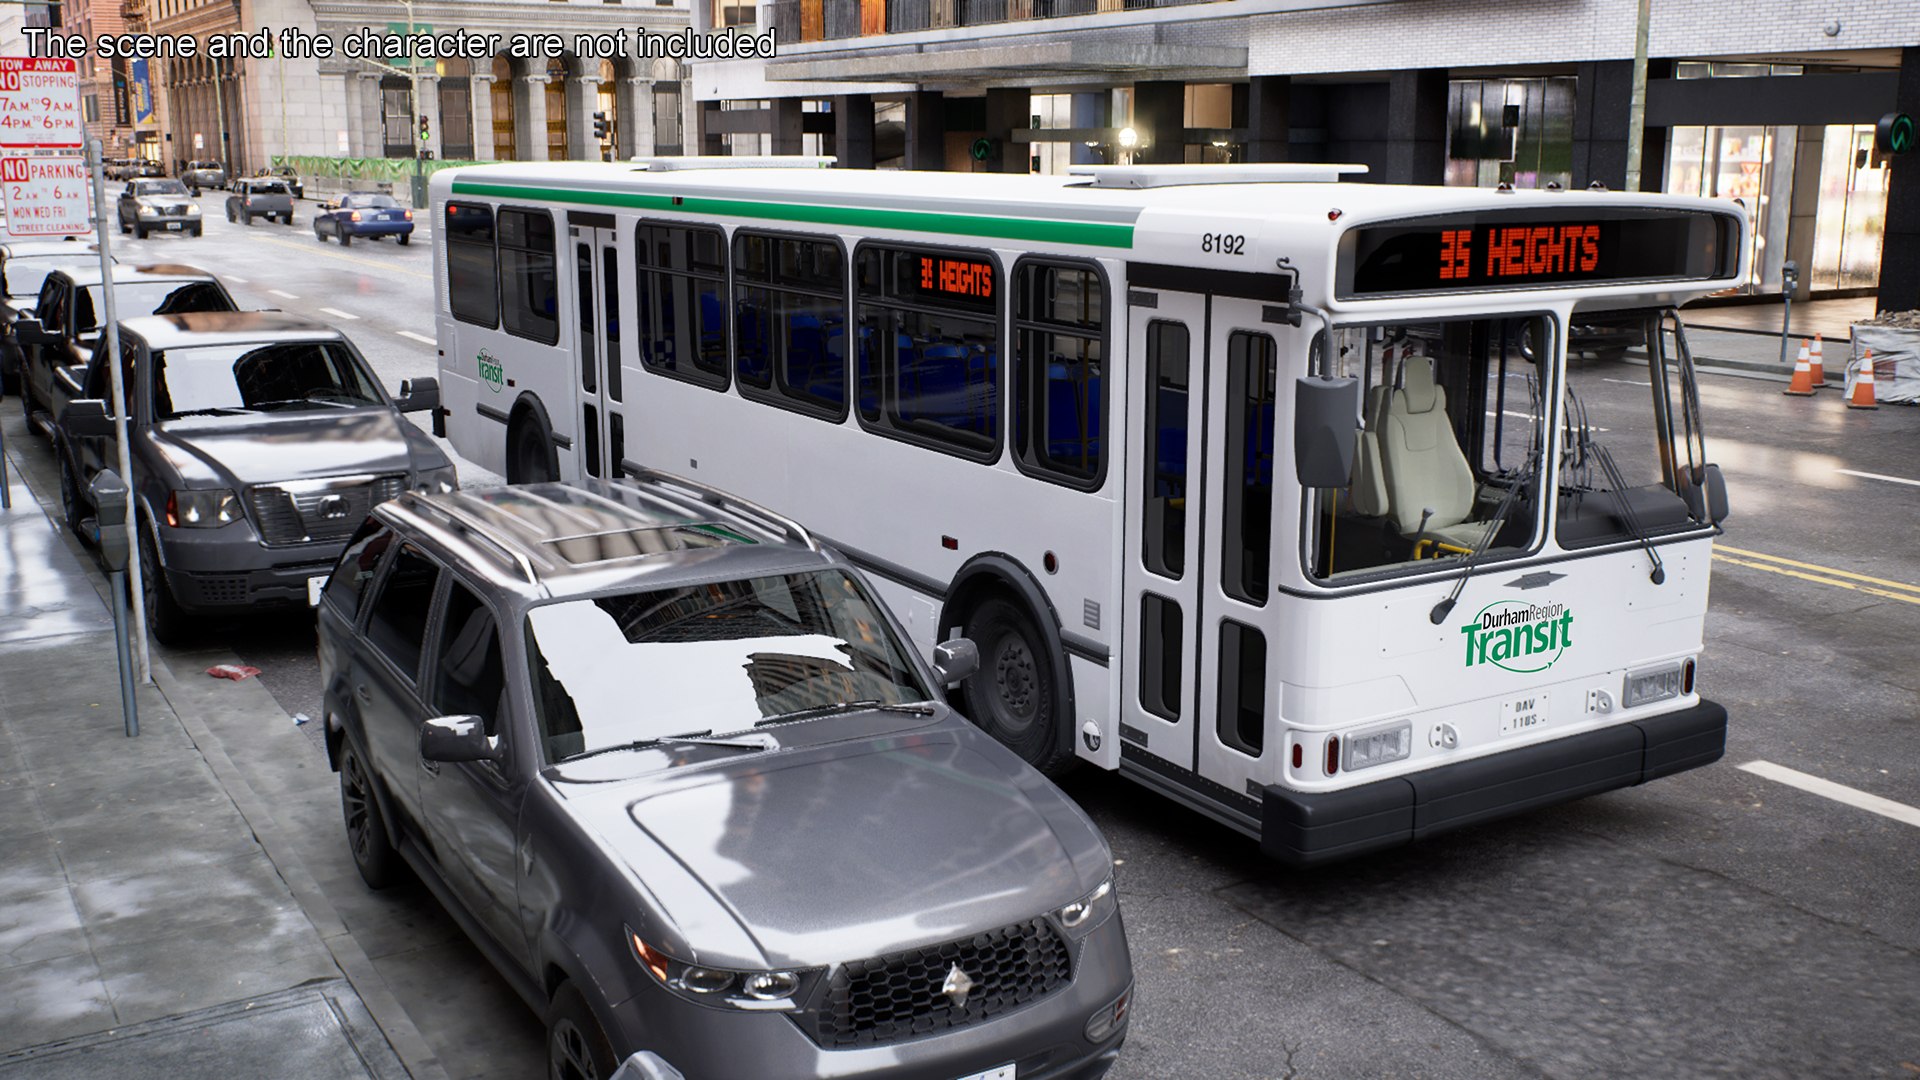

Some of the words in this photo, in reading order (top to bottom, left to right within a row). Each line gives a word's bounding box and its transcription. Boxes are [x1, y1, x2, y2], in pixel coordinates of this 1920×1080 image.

[22, 75, 74, 88] STOPPING
[4, 160, 28, 180] NO
[31, 164, 83, 179] PARKING
[54, 185, 62, 199] 6
[13, 206, 31, 219] MON
[33, 206, 51, 218] WED
[53, 206, 66, 217] FRI
[16, 224, 44, 232] STREET
[46, 223, 85, 231] CLEANING
[1201, 232, 1245, 255] 8192
[1440, 230, 1472, 279] 35
[1487, 225, 1599, 276] HEIGHTS
[939, 259, 992, 297] HEIGHTS
[477, 355, 503, 386] Transit
[1461, 608, 1573, 667] Transit
[1515, 698, 1535, 712] DAV
